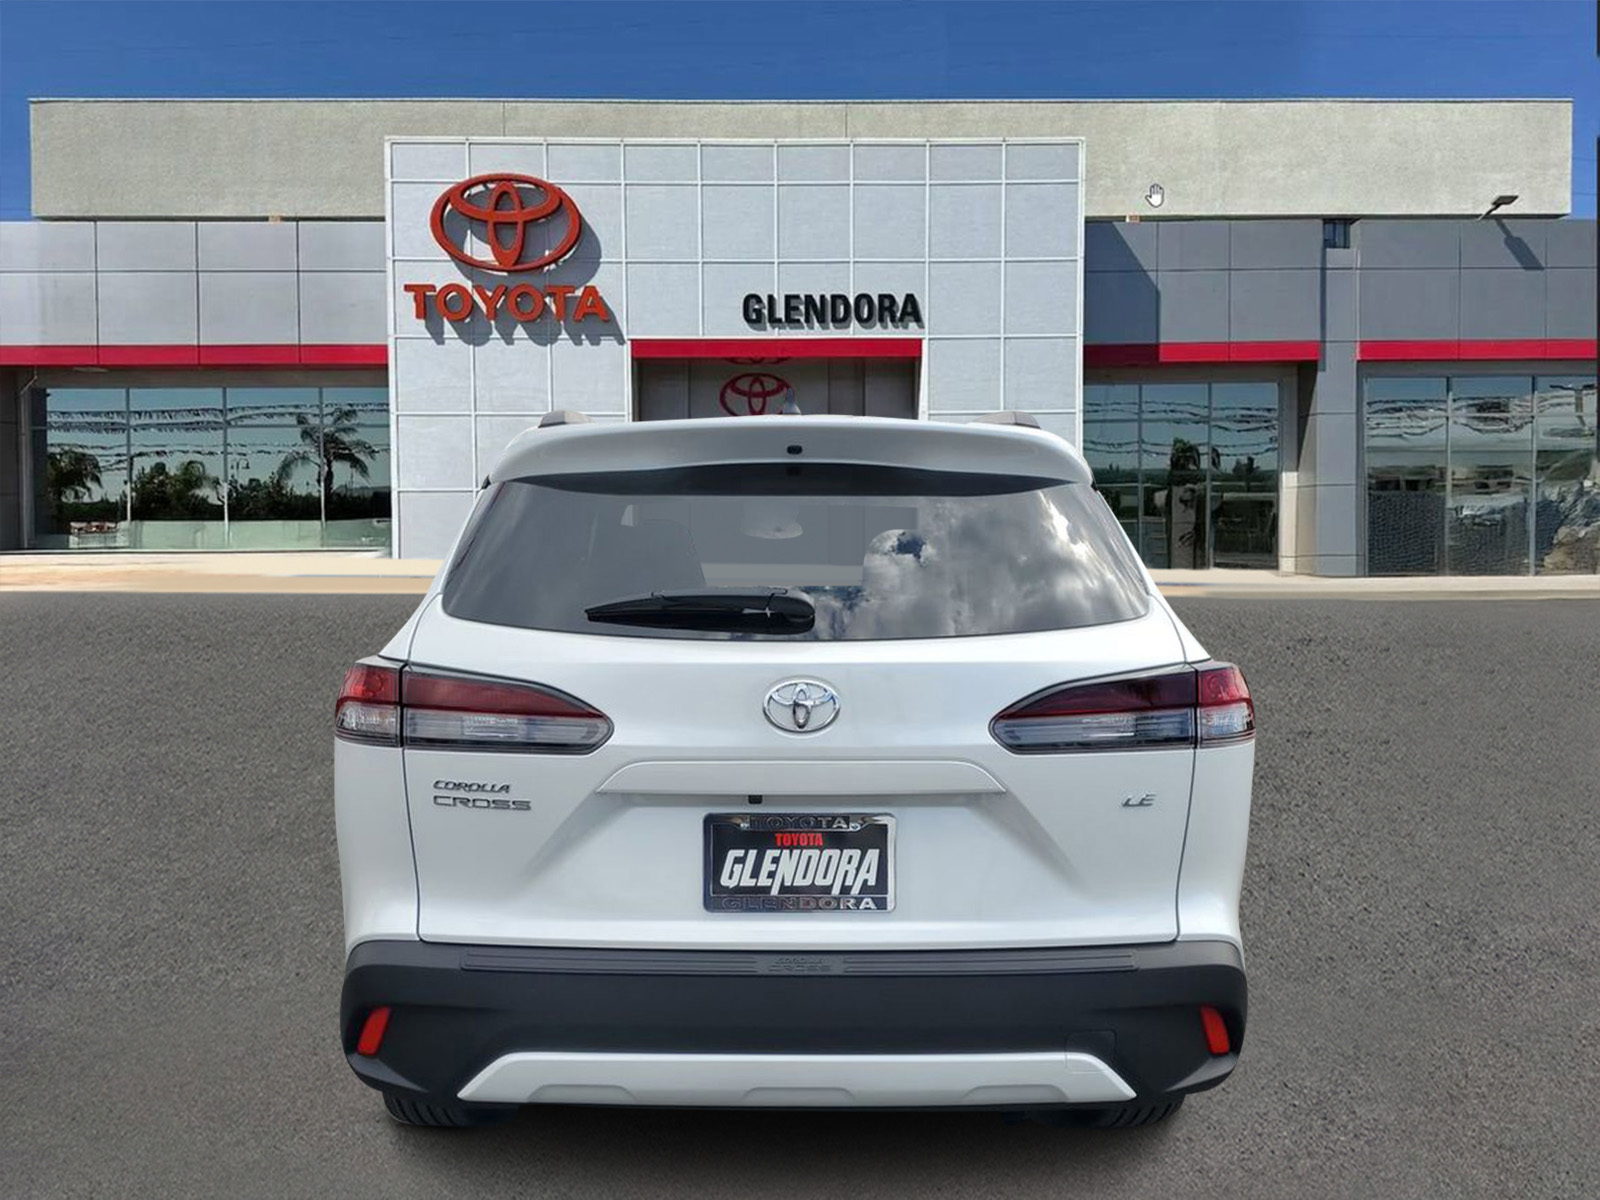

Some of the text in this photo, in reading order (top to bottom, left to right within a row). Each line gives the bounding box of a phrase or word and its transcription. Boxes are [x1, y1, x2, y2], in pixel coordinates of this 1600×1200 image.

[404, 283, 609, 322] TOYOTA
[742, 293, 923, 324] GLENDORA
[433, 780, 510, 793] COROLLA
[433, 795, 531, 811] CROSS
[1122, 794, 1157, 807] LE
[751, 815, 848, 829] TOYOTA
[775, 833, 824, 846] TOYOTA
[720, 849, 880, 895] GLENDORA
[721, 897, 878, 910] GLENDORA
